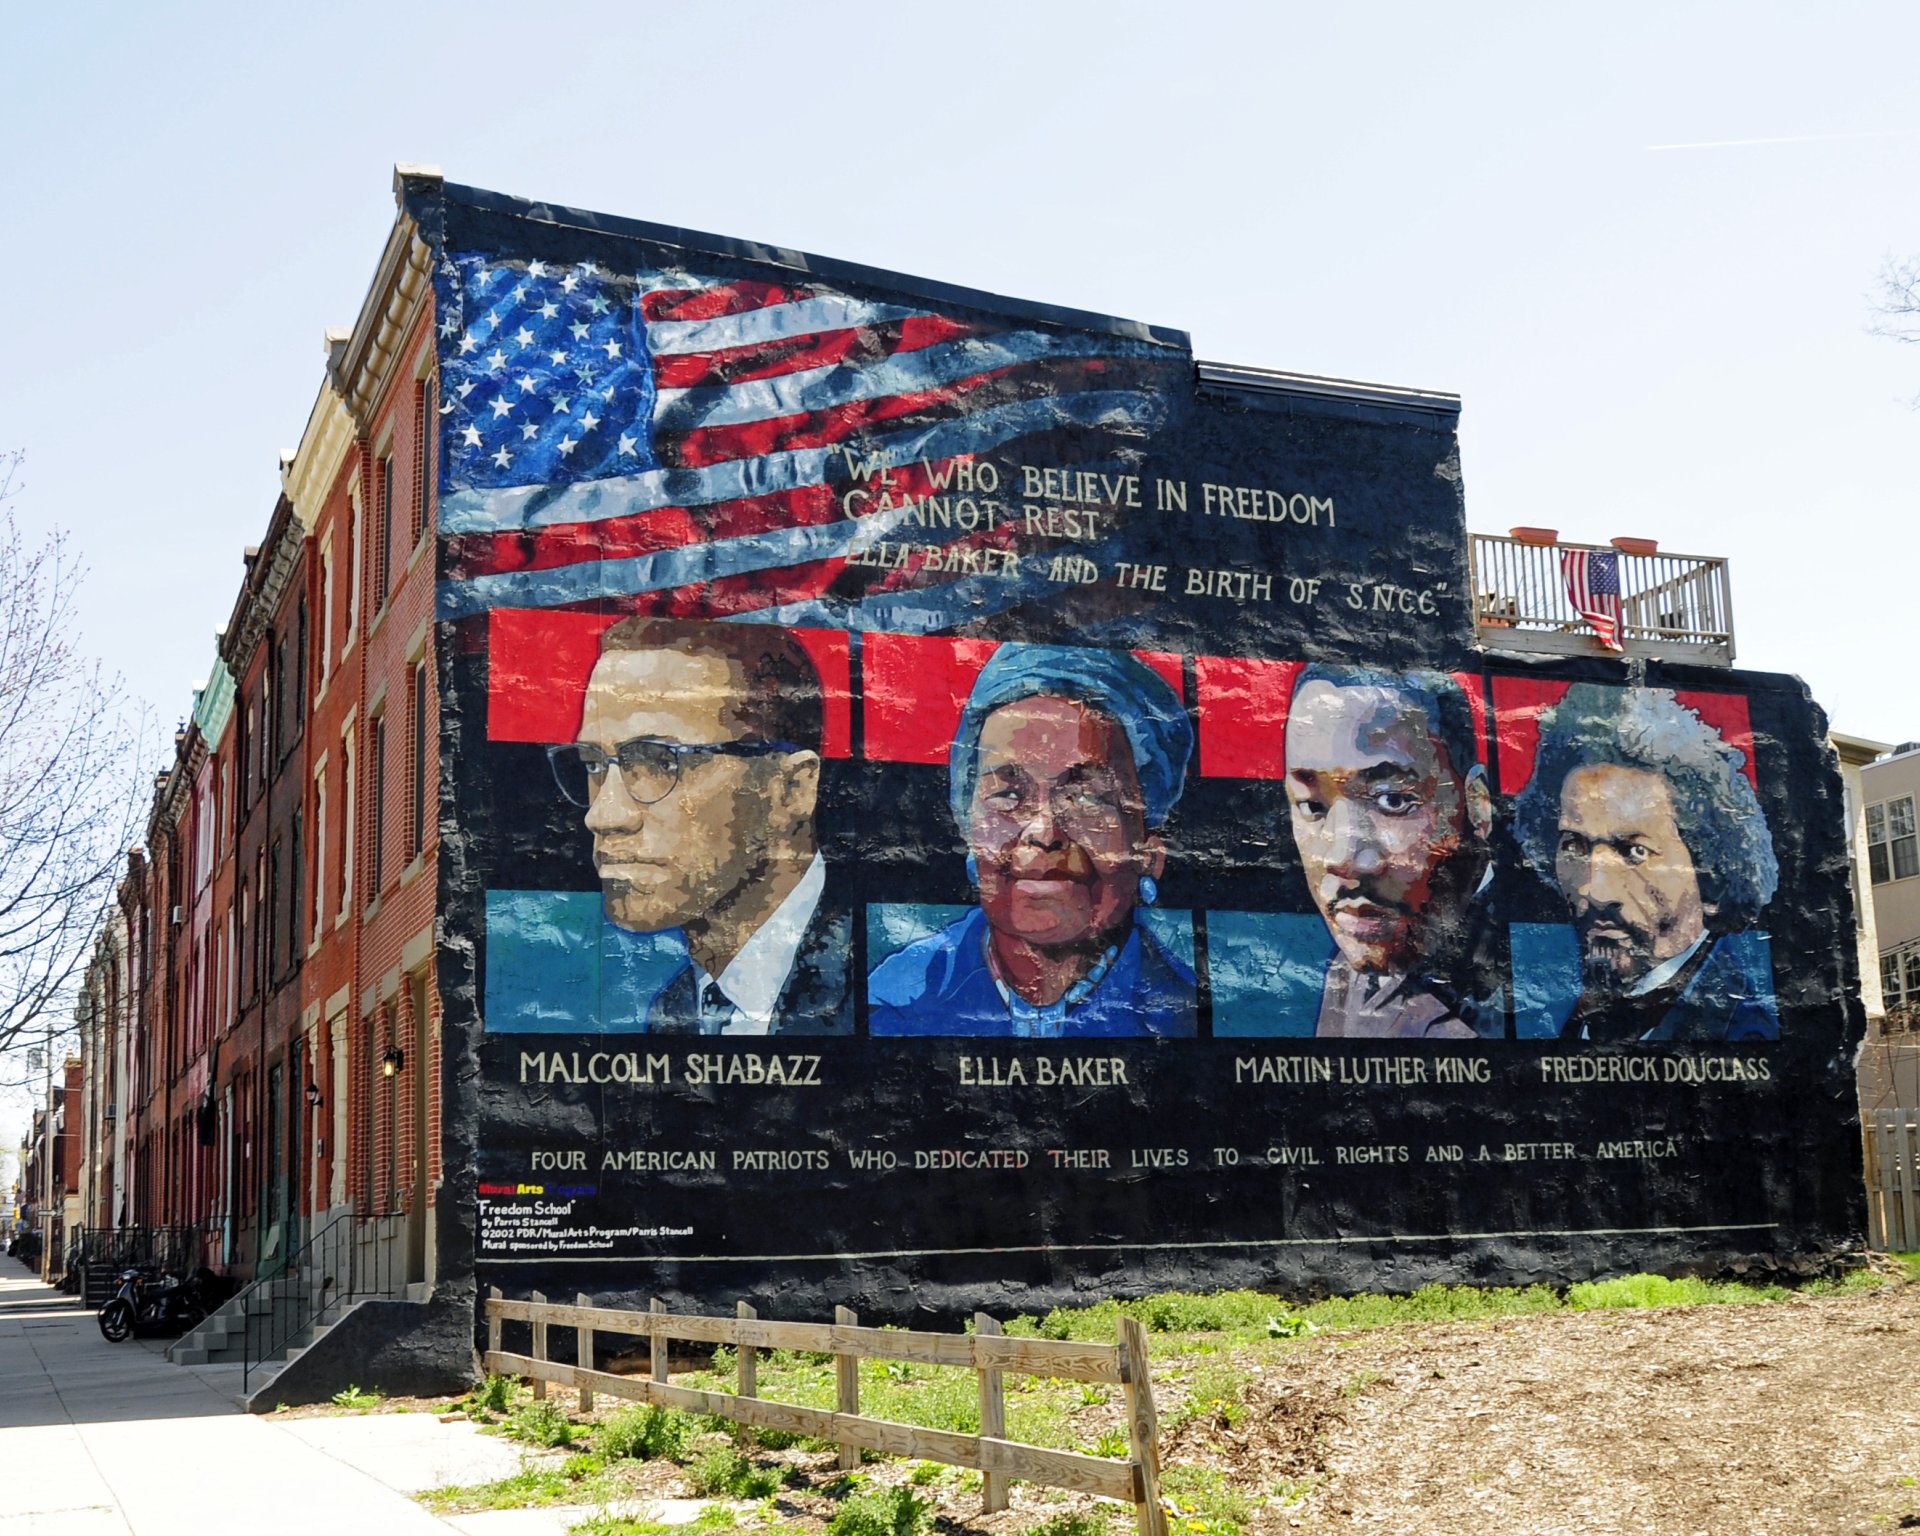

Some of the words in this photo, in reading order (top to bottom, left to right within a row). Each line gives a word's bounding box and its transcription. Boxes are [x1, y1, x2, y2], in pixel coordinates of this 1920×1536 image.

[923, 455, 998, 493] WHO
[1021, 465, 1142, 508] BELIEVE
[1156, 478, 1188, 512] IN
[1202, 483, 1336, 527] FREEDOM
[843, 489, 999, 532] CANNOT
[844, 537, 909, 569] ELLA
[921, 544, 1021, 578] BAKER
[1047, 556, 1099, 585] AND
[1114, 562, 1166, 592] THE
[1184, 568, 1273, 601] BIRTH
[1289, 578, 1321, 605] OF
[519, 1052, 671, 1084] MALCOLM
[684, 1053, 822, 1086] SHABAZZ
[959, 1056, 1028, 1086] ELLA
[1036, 1056, 1130, 1086] BAKER
[1235, 1056, 1331, 1084] MARTIN
[1338, 1056, 1427, 1085] LUTHER
[1434, 1057, 1491, 1084] KING
[1541, 1056, 1659, 1083] FREDERICK
[531, 1151, 588, 1171] FOUR
[601, 1150, 716, 1171] AMERICAN
[732, 1150, 830, 1171] PATRIOTS
[848, 1150, 897, 1170] WHO
[914, 1150, 1029, 1170] DEDICATED
[1047, 1150, 1111, 1169] THEIR
[1131, 1148, 1189, 1168] LIVES
[1213, 1148, 1239, 1167] TO
[1336, 1146, 1410, 1165] RIGHTS
[1425, 1145, 1464, 1162] AND
[1478, 1144, 1492, 1162] A
[1504, 1142, 1576, 1161] BETTER
[1596, 1140, 1678, 1159] AMERICA
[516, 1184, 544, 1195] Arts
[481, 1218, 493, 1229] By
[494, 1216, 521, 1227] Parris
[482, 1239, 507, 1250] Mural
[548, 1240, 558, 1252] by
